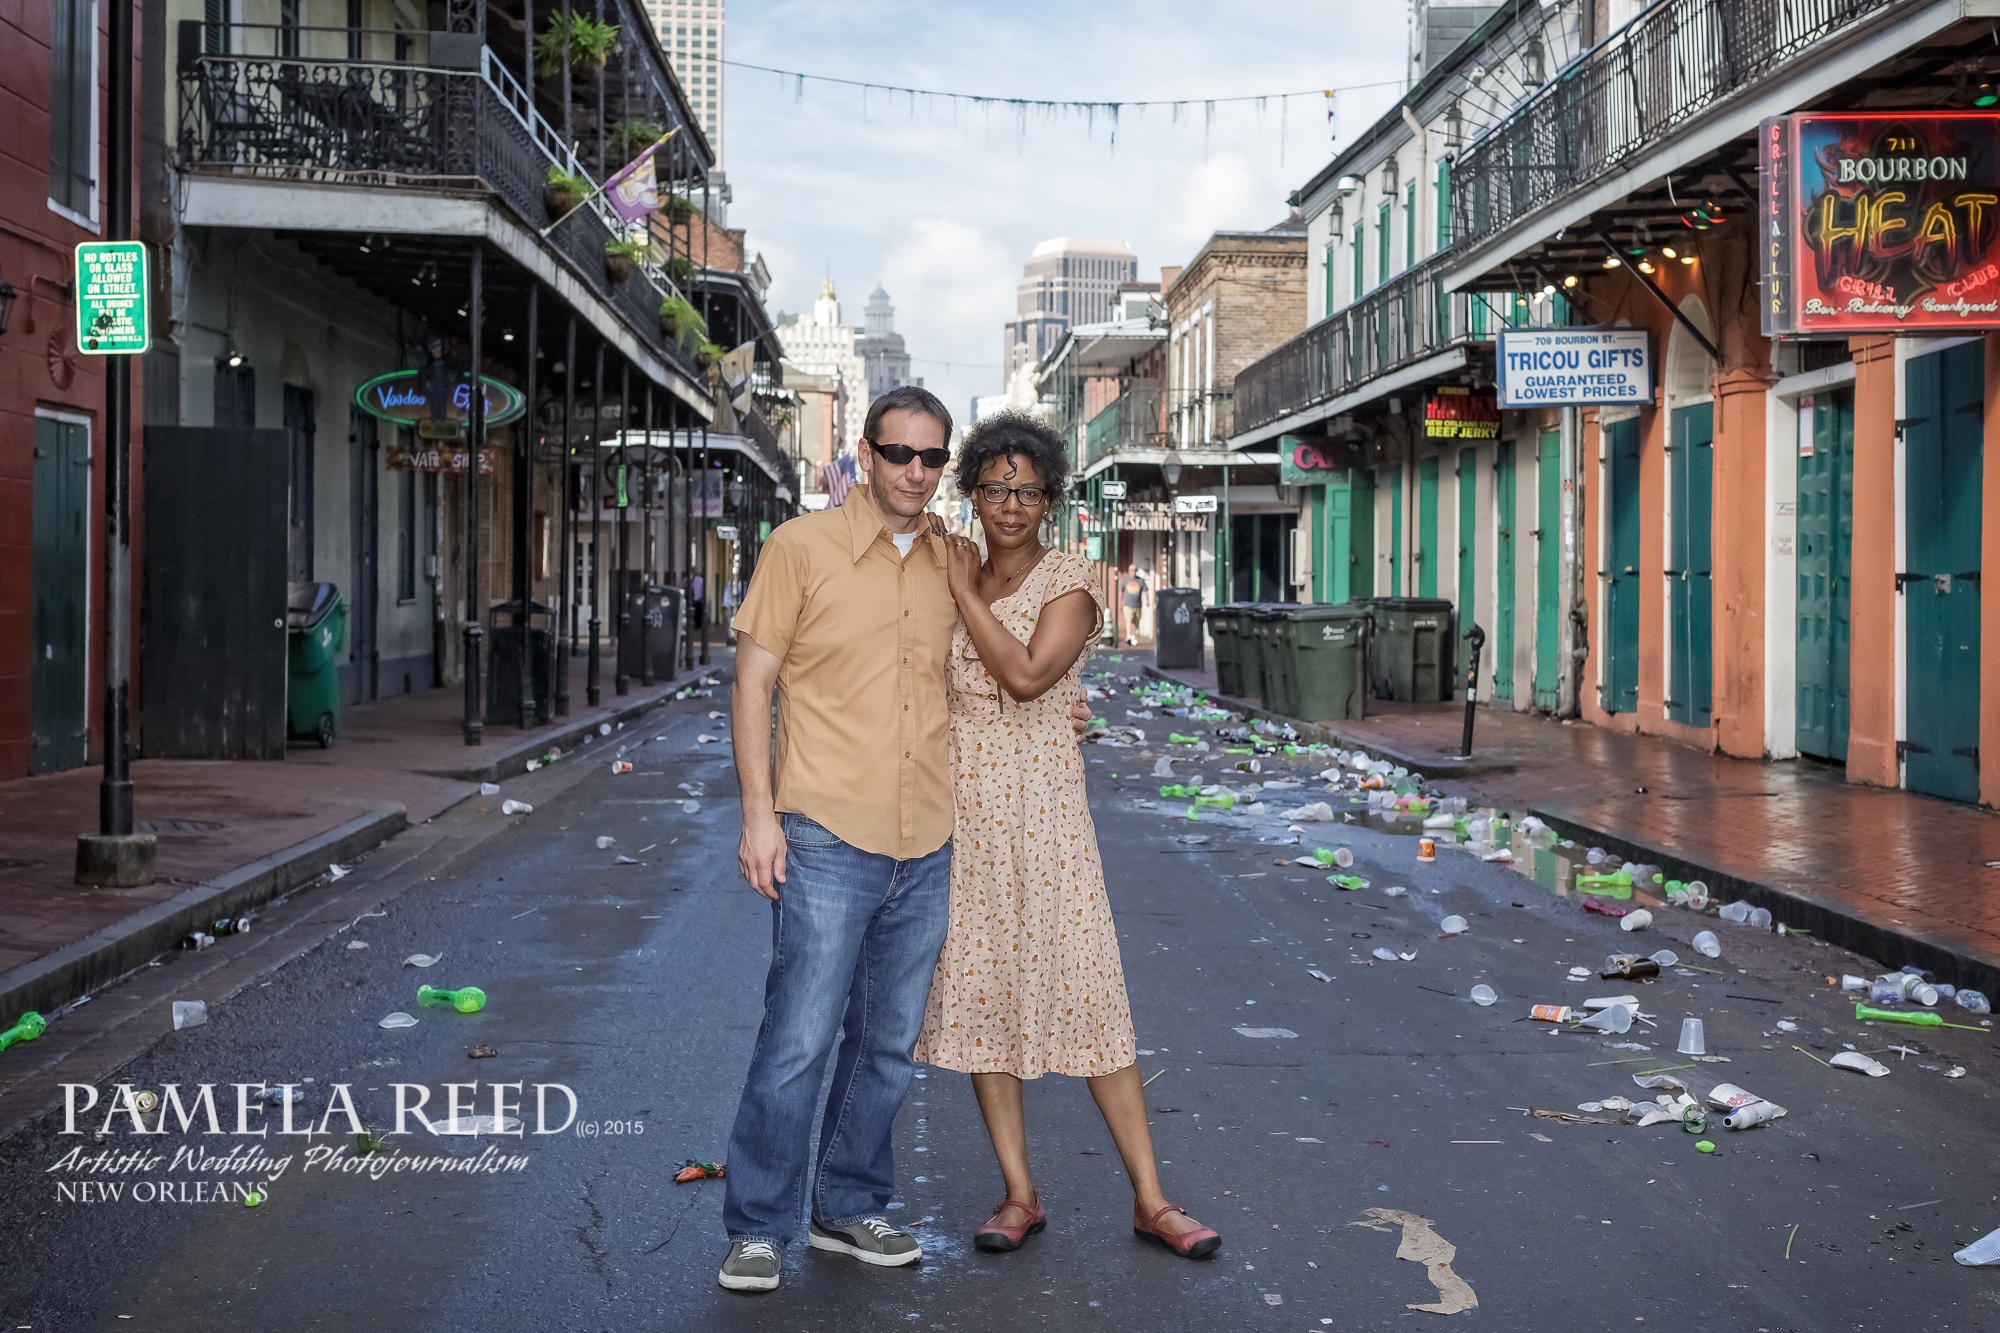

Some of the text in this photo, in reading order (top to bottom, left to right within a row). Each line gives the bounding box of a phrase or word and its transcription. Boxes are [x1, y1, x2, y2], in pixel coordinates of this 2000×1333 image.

[1888, 138, 1915, 151] 711
[1771, 124, 1781, 216] GRILL
[1838, 156, 1967, 182] BOURBON
[1819, 191, 1998, 281] HEAT
[83, 251, 138, 263] NO BOTTLES
[89, 262, 134, 273] OR GLASS
[91, 273, 132, 284] ALLOWED
[1771, 242, 1781, 314] CLUB
[1838, 264, 1999, 302] GRILL CLUB
[87, 282, 136, 294] ON STREET
[90, 299, 105, 309] ALL
[1845, 297, 1915, 319] Balcony
[1920, 297, 1998, 317] Courtyard
[1535, 334, 1616, 346] 709 BOURBON ST.
[1508, 347, 1644, 371] TRICOU GIFTS
[1525, 373, 1627, 387] GUARANTEED
[377, 385, 426, 410] Voodoo
[1515, 385, 1637, 400] LOWEST PRICES
[1427, 426, 1498, 438] BEEF JERKY
[452, 453, 486, 469] SHP
